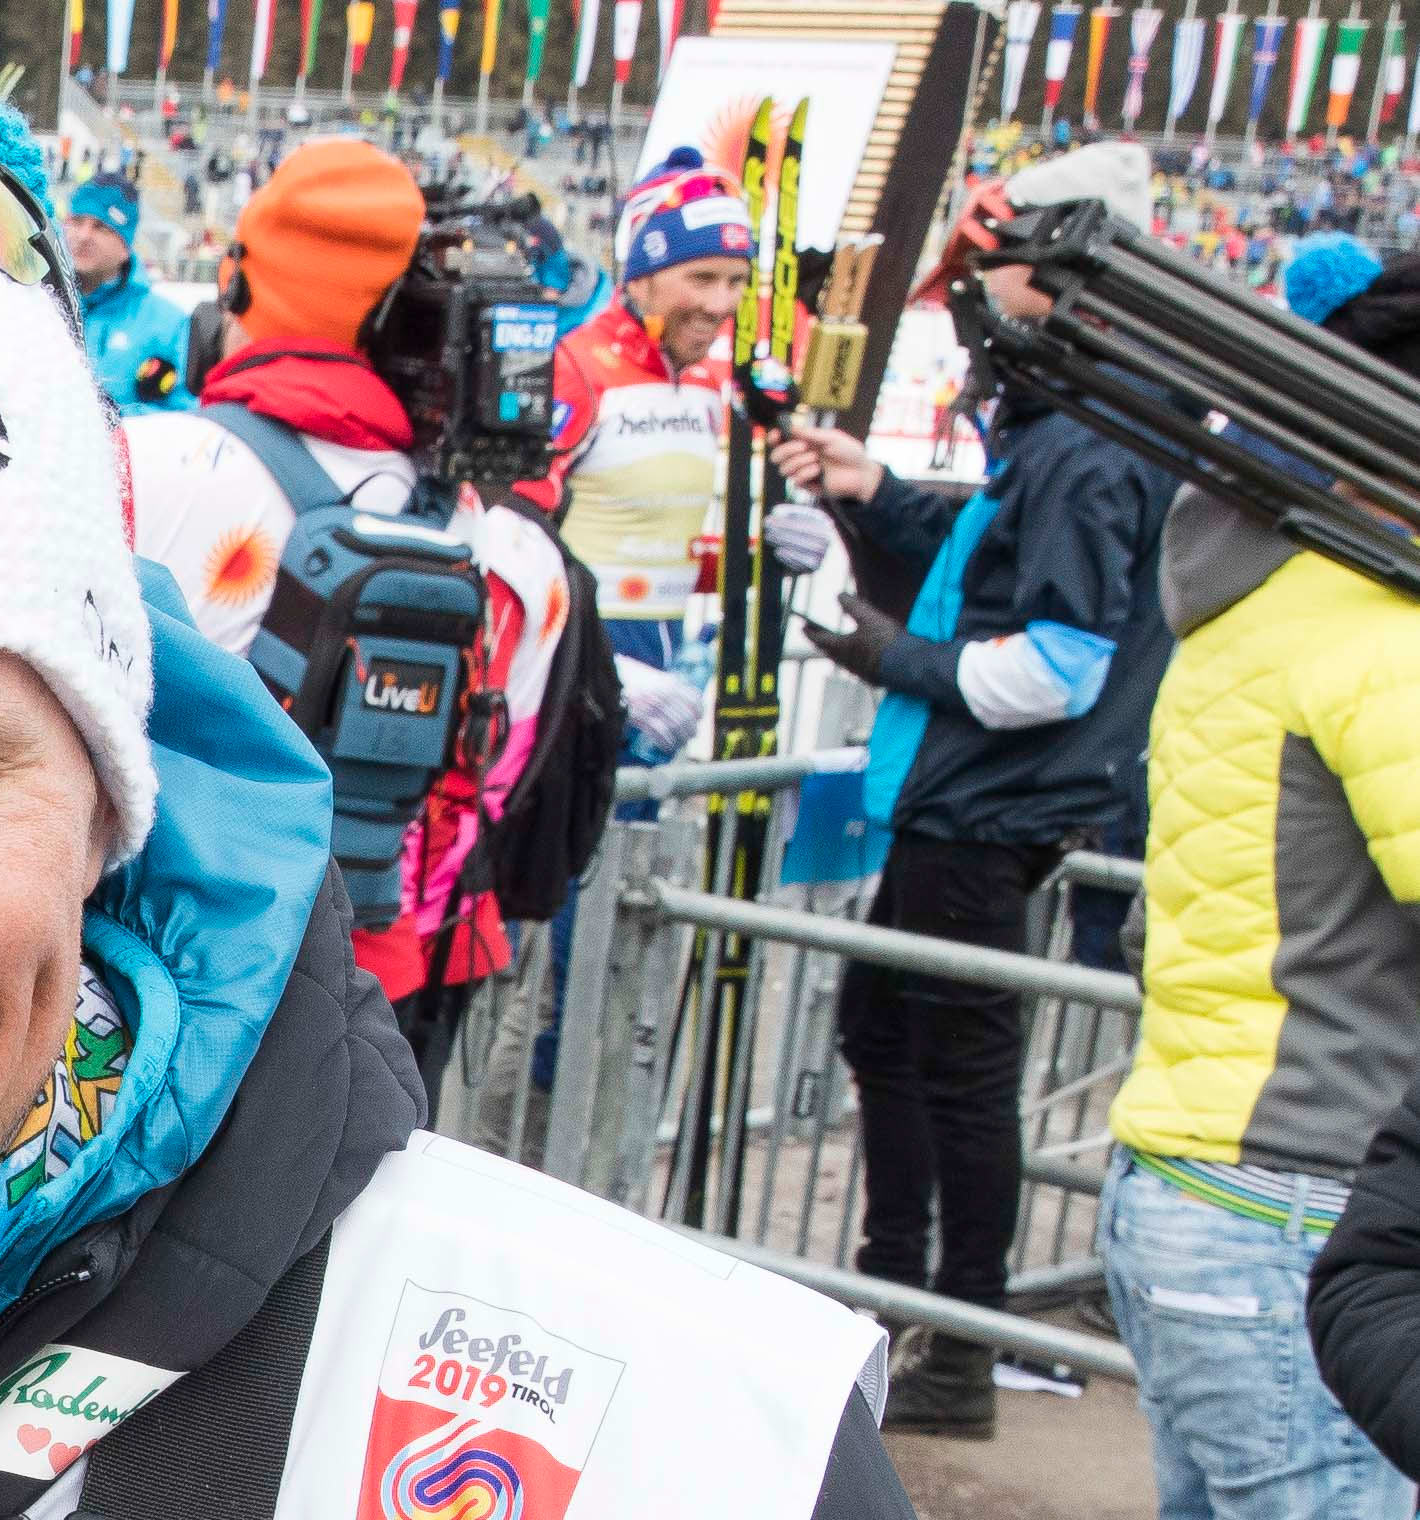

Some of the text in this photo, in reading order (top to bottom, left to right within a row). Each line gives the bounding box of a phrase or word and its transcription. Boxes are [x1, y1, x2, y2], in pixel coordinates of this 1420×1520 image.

[365, 670, 438, 713] LiveU
[407, 1354, 557, 1425] 2019 TIROL
[419, 1308, 575, 1405] Seefeld
